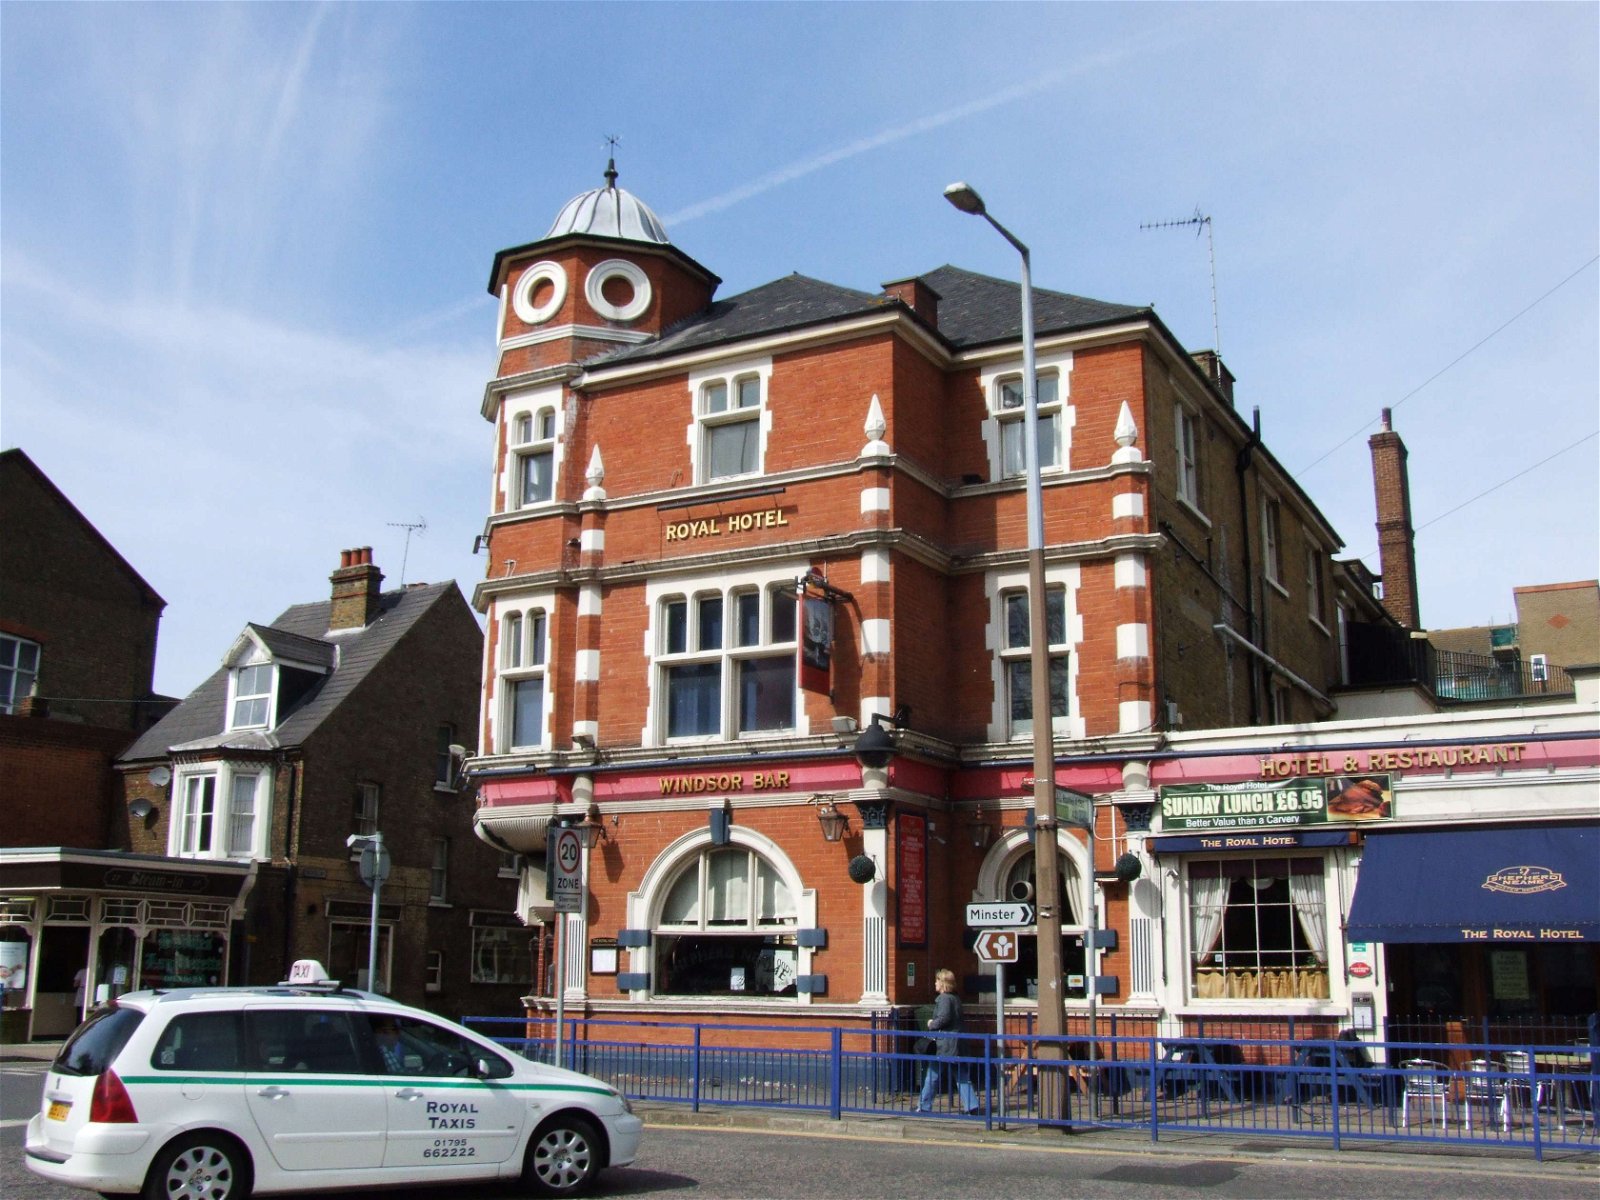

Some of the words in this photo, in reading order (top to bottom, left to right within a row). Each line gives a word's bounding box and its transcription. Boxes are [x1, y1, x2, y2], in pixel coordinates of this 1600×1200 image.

[666, 519, 720, 540] ROYAL
[728, 509, 788, 532] HOTEL
[1261, 755, 1335, 777] HOTEL
[1343, 755, 1358, 772] &
[1368, 744, 1526, 771] RESTAURANT
[658, 773, 743, 794] WINDSOR
[752, 770, 790, 789] BAR
[1207, 784, 1221, 792] The
[1222, 782, 1246, 792] Royal
[1247, 781, 1268, 790] Hotel
[1163, 794, 1220, 817] SUNDAY
[1225, 792, 1274, 814] LUNCH
[1276, 790, 1324, 811] £6.95
[1186, 818, 1211, 828] Better
[1212, 817, 1236, 827] Value
[1238, 816, 1257, 826] than
[1266, 815, 1300, 826] Carvery
[1201, 839, 1221, 847] THE
[1226, 838, 1258, 847] ROYAL
[1263, 836, 1297, 846] HOTEL
[561, 843, 577, 861] 20
[557, 877, 579, 889] ZONE
[1491, 874, 1558, 882] SHEPHERD
[970, 909, 1015, 920] Minster
[1462, 929, 1488, 938] THE
[1493, 929, 1535, 938] ROYAL
[1540, 928, 1584, 938] HOTEL
[293, 965, 311, 978] TAXI
[426, 1101, 479, 1114] ROYAL
[428, 1116, 475, 1129] TAXIS
[434, 1138, 467, 1147] 01795
[423, 1147, 475, 1158] 662222
